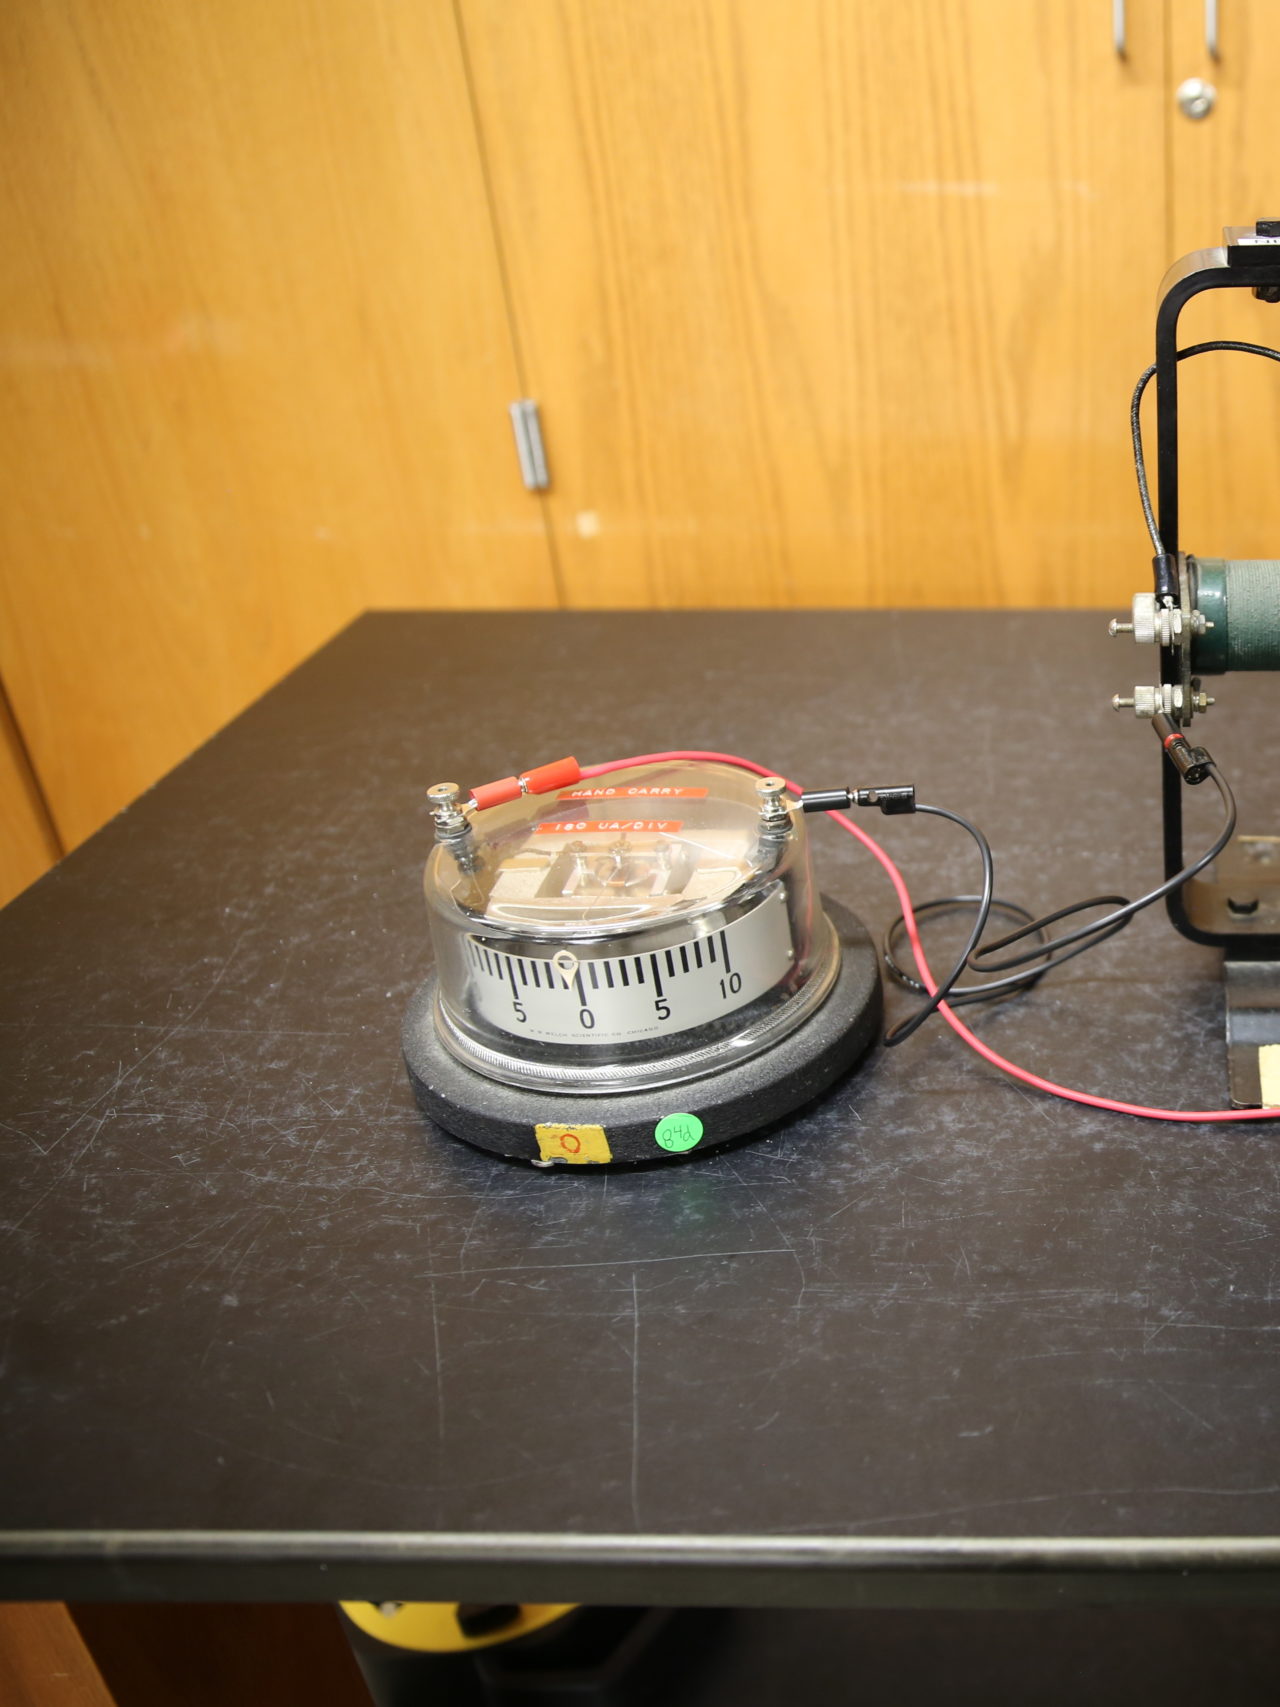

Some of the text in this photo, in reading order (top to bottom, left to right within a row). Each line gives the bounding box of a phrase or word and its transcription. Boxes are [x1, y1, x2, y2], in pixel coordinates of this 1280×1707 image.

[571, 787, 685, 798] HAND CARRY
[512, 972, 743, 1030] 5 0 5 10
